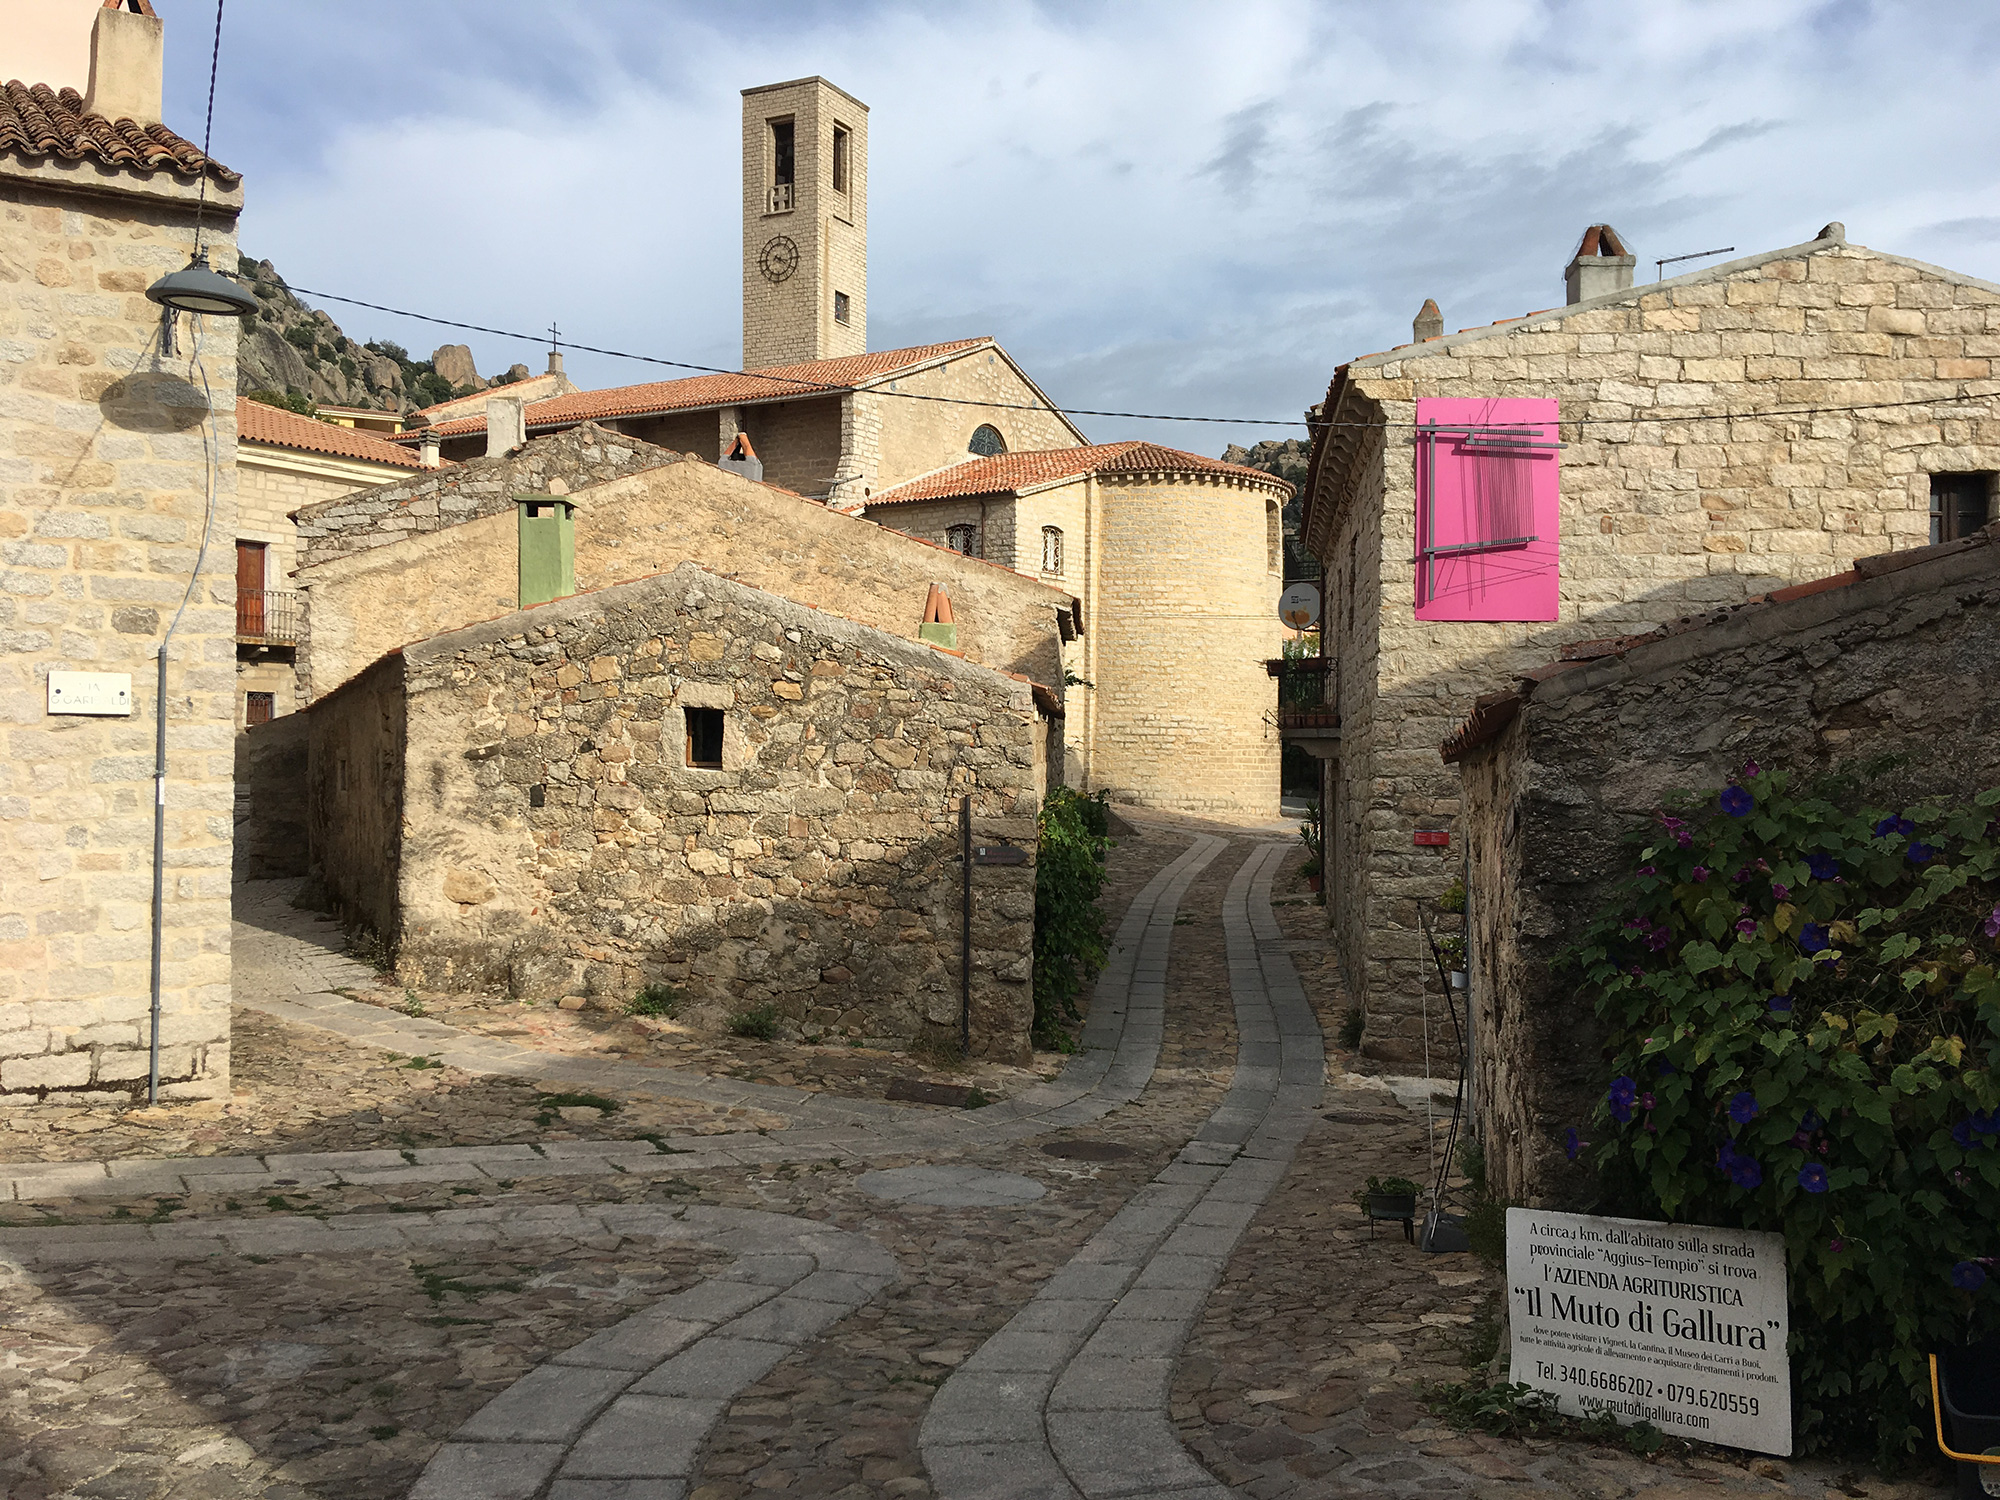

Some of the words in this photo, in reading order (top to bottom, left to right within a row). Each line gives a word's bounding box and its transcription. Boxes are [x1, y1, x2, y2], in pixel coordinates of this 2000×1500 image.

[1530, 1222, 1538, 1235] A
[1540, 1224, 1569, 1239] circa
[1580, 1226, 1603, 1242] km.
[1606, 1229, 1674, 1250] dall'abitato
[1677, 1237, 1708, 1254] sulla
[1712, 1242, 1755, 1258] strada
[1530, 1244, 1595, 1260] provinciale
[1708, 1262, 1719, 1275] si
[1723, 1264, 1757, 1279] trova
[1544, 1264, 1619, 1291] l'AZIENDA
[1622, 1276, 1744, 1307] AGRITURISTICA
[1514, 1286, 1543, 1318] "Il
[1550, 1292, 1620, 1329] Muto
[1628, 1300, 1654, 1334] di
[1663, 1308, 1780, 1351] Gallura"
[1519, 1335, 1535, 1344] tutte
[1536, 1336, 1542, 1346] le
[1567, 1343, 1594, 1354] agricole
[1595, 1345, 1602, 1355] di
[1603, 1347, 1646, 1362] allevamento
[1653, 1357, 1692, 1370] acquistare
[1746, 1370, 1779, 1384] prodotti.
[1533, 1325, 1549, 1336] dove
[1550, 1328, 1571, 1339] potete
[1572, 1331, 1598, 1343] visitare
[1629, 1340, 1636, 1350] la
[1668, 1345, 1673, 1354] il
[1674, 1348, 1700, 1359] Museo
[1701, 1350, 1712, 1361] dei
[1714, 1353, 1734, 1365] Carri
[1734, 1358, 1740, 1366] a
[1536, 1360, 1557, 1381] Tel.
[1560, 1365, 1653, 1398] 340.6686202
[1667, 1383, 1759, 1416] 079.620559
[1578, 1394, 1709, 1429] wwwmutodigallura.com
